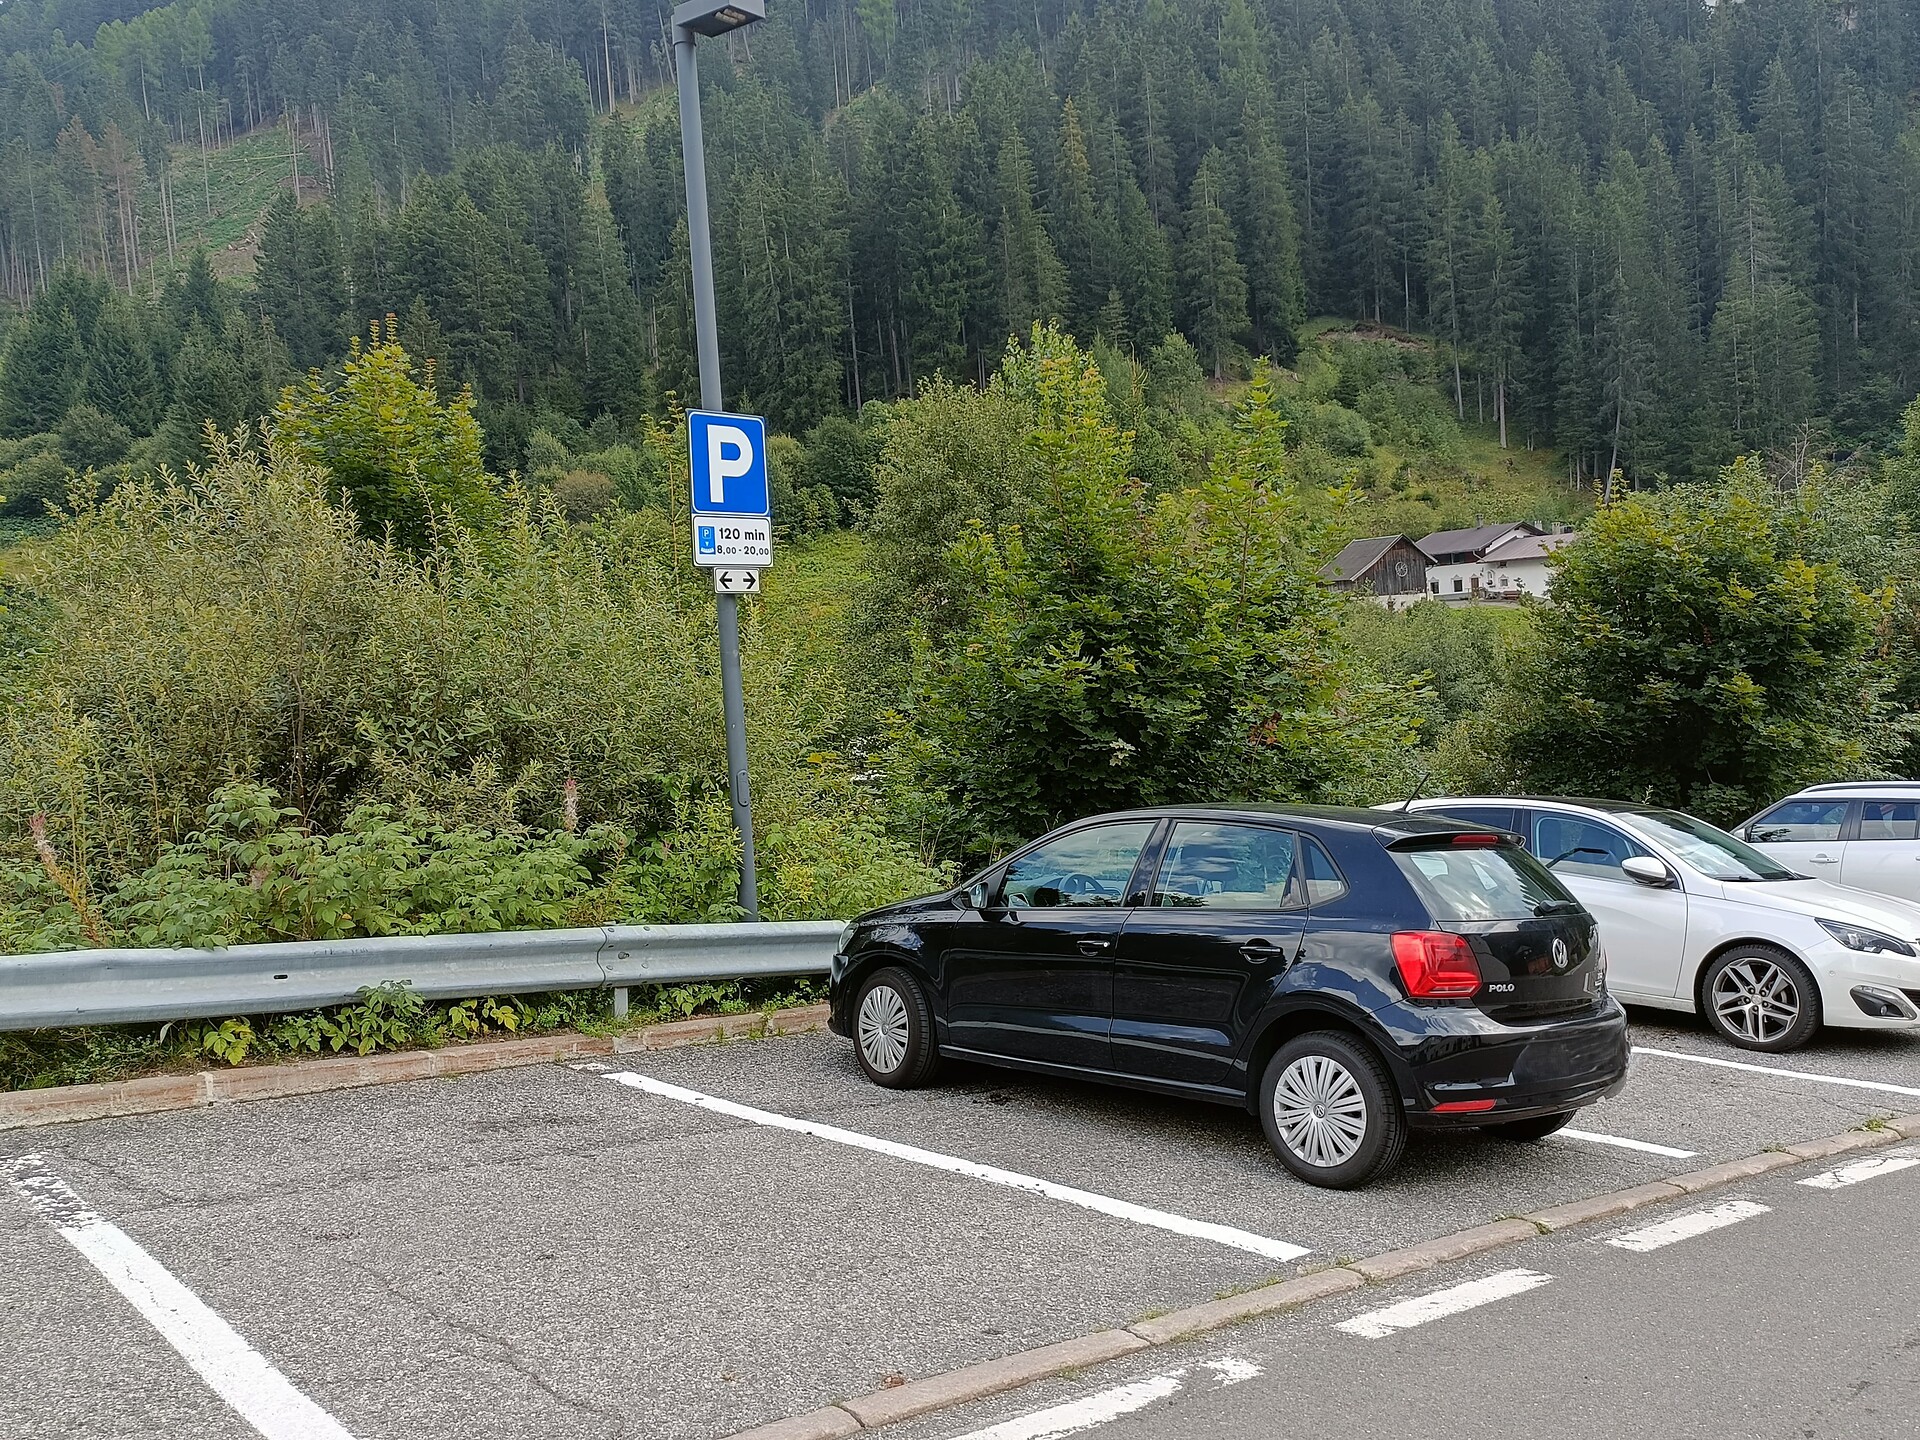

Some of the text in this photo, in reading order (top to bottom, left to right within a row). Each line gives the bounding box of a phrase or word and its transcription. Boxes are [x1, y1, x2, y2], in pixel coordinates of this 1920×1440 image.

[706, 424, 754, 503] P
[719, 527, 765, 541] 120 min
[1488, 983, 1515, 993] POLO
